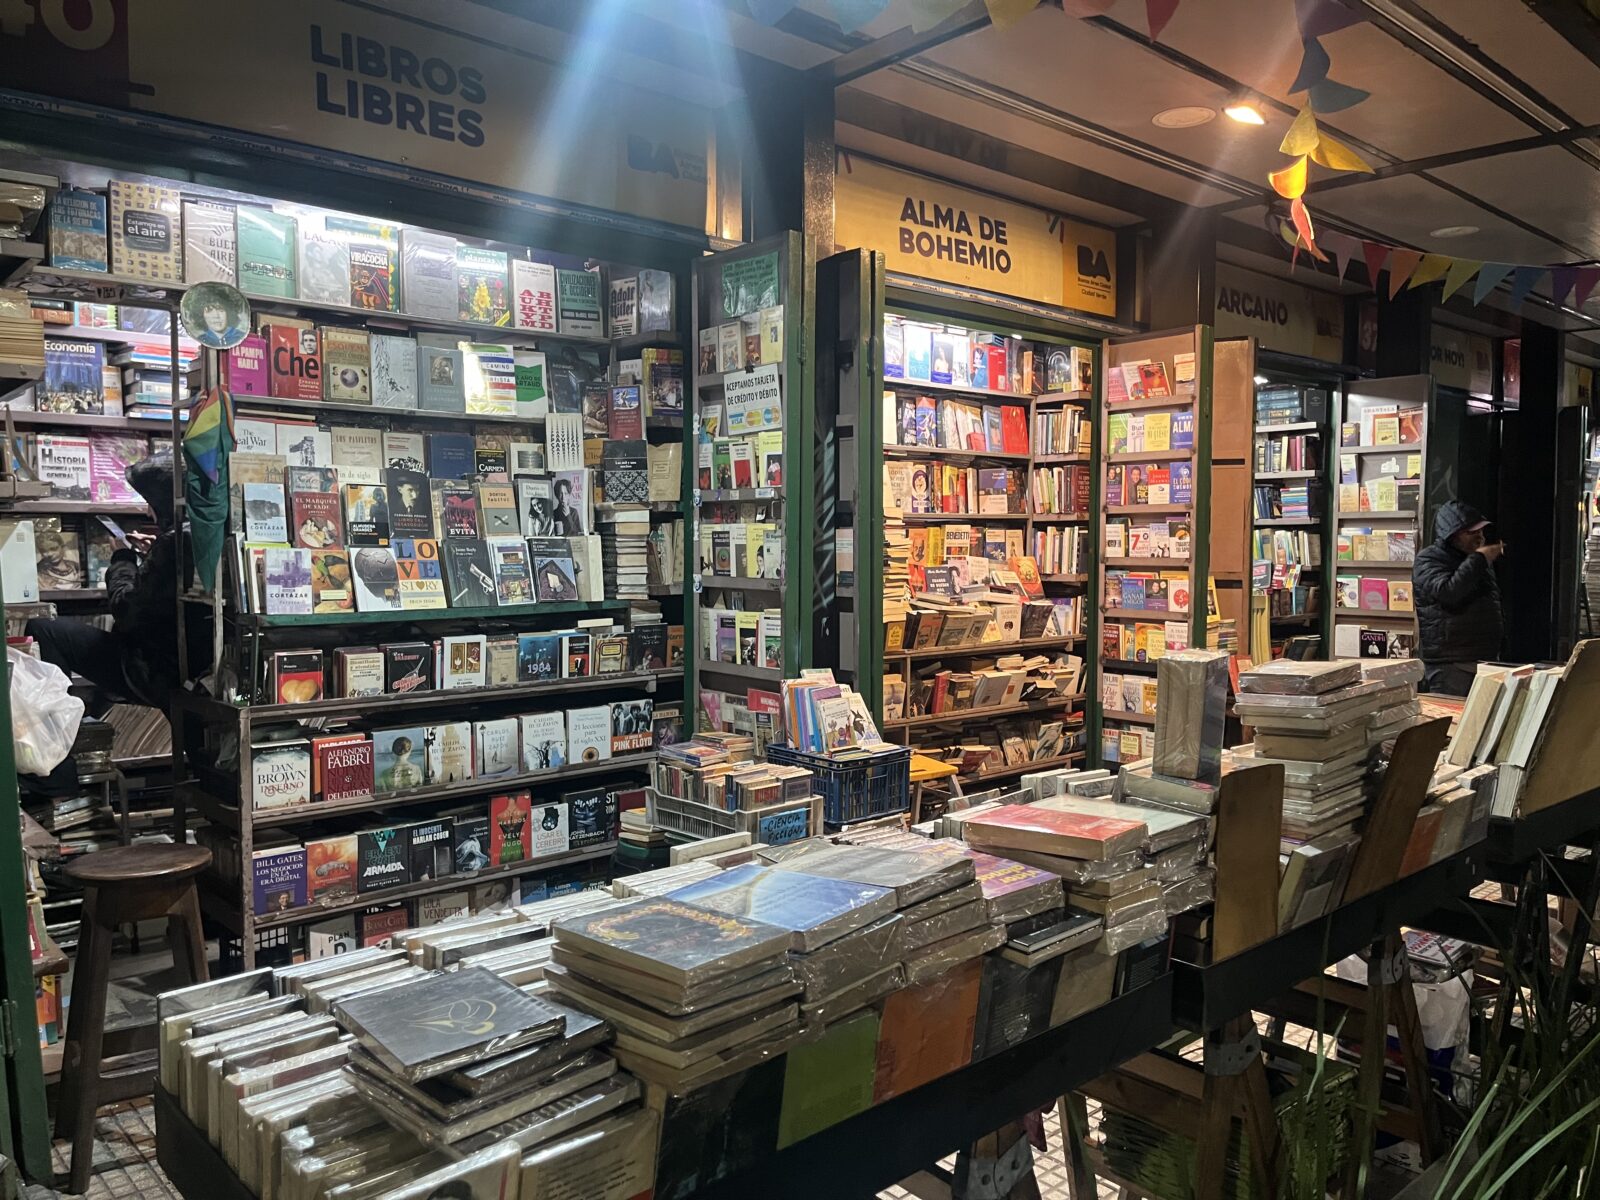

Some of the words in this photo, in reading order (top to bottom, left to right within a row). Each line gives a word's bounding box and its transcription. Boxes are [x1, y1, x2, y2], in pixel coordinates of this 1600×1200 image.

[310, 24, 486, 105] LIBROS
[316, 71, 485, 147] LIBRES
[127, 219, 156, 228] Estamos
[900, 197, 973, 237] ALMA
[978, 215, 1008, 246] DE
[128, 226, 139, 234] el
[141, 227, 167, 238] aire
[899, 227, 1012, 275] BOHEMIO
[350, 251, 388, 266] VIRACOCHA
[611, 286, 636, 303] Adolf
[611, 302, 634, 319] Hitler
[1217, 287, 1289, 326] ARCANO
[44, 340, 96, 354] Economía
[232, 348, 241, 357] LA
[241, 348, 264, 360] PAMPA
[238, 359, 258, 370] HABLA
[273, 346, 319, 379] Che
[726, 378, 754, 392] ACEPTAMOS
[754, 374, 775, 387] TARJETA
[728, 396, 734, 406] DE
[734, 392, 755, 405] CRÉDITO
[758, 388, 778, 400] DÉBITO
[237, 437, 249, 445] eal
[250, 437, 267, 447] War
[41, 448, 87, 465] HISTORIA
[478, 463, 505, 472] CARMEN
[946, 531, 970, 541] BENEDETTI
[1131, 534, 1141, 551] 7
[397, 541, 412, 559] L
[417, 541, 436, 559] O
[396, 560, 415, 579] V
[420, 561, 437, 579] E
[1362, 634, 1386, 642] GANDHI
[527, 661, 552, 674] 1984
[486, 728, 510, 736] CARLOS
[492, 735, 506, 743] RUIZ
[580, 738, 594, 746] siglo
[613, 739, 630, 751] PINK
[632, 736, 653, 748] FLOYD
[327, 746, 371, 758] ALEJANDRO
[271, 762, 294, 774] DAN
[327, 754, 370, 769] FABBRI
[258, 769, 307, 785] BROWN
[327, 791, 341, 800] DEL
[412, 834, 432, 845] HARLAN
[498, 831, 525, 840] EVELYN
[568, 830, 605, 841] KATZENBACH
[501, 840, 522, 848] HUGO
[256, 857, 276, 868] BILL
[277, 854, 303, 865] GATES
[256, 868, 267, 876] LOS
[268, 862, 304, 875] NEGOCIOS
[363, 861, 405, 877] ARMADA
[260, 877, 274, 886] ERA
[275, 873, 301, 884] DIGITAL
[423, 906, 464, 920] VENDETTA
[328, 931, 350, 944] PLAN
[334, 943, 347, 956] D
